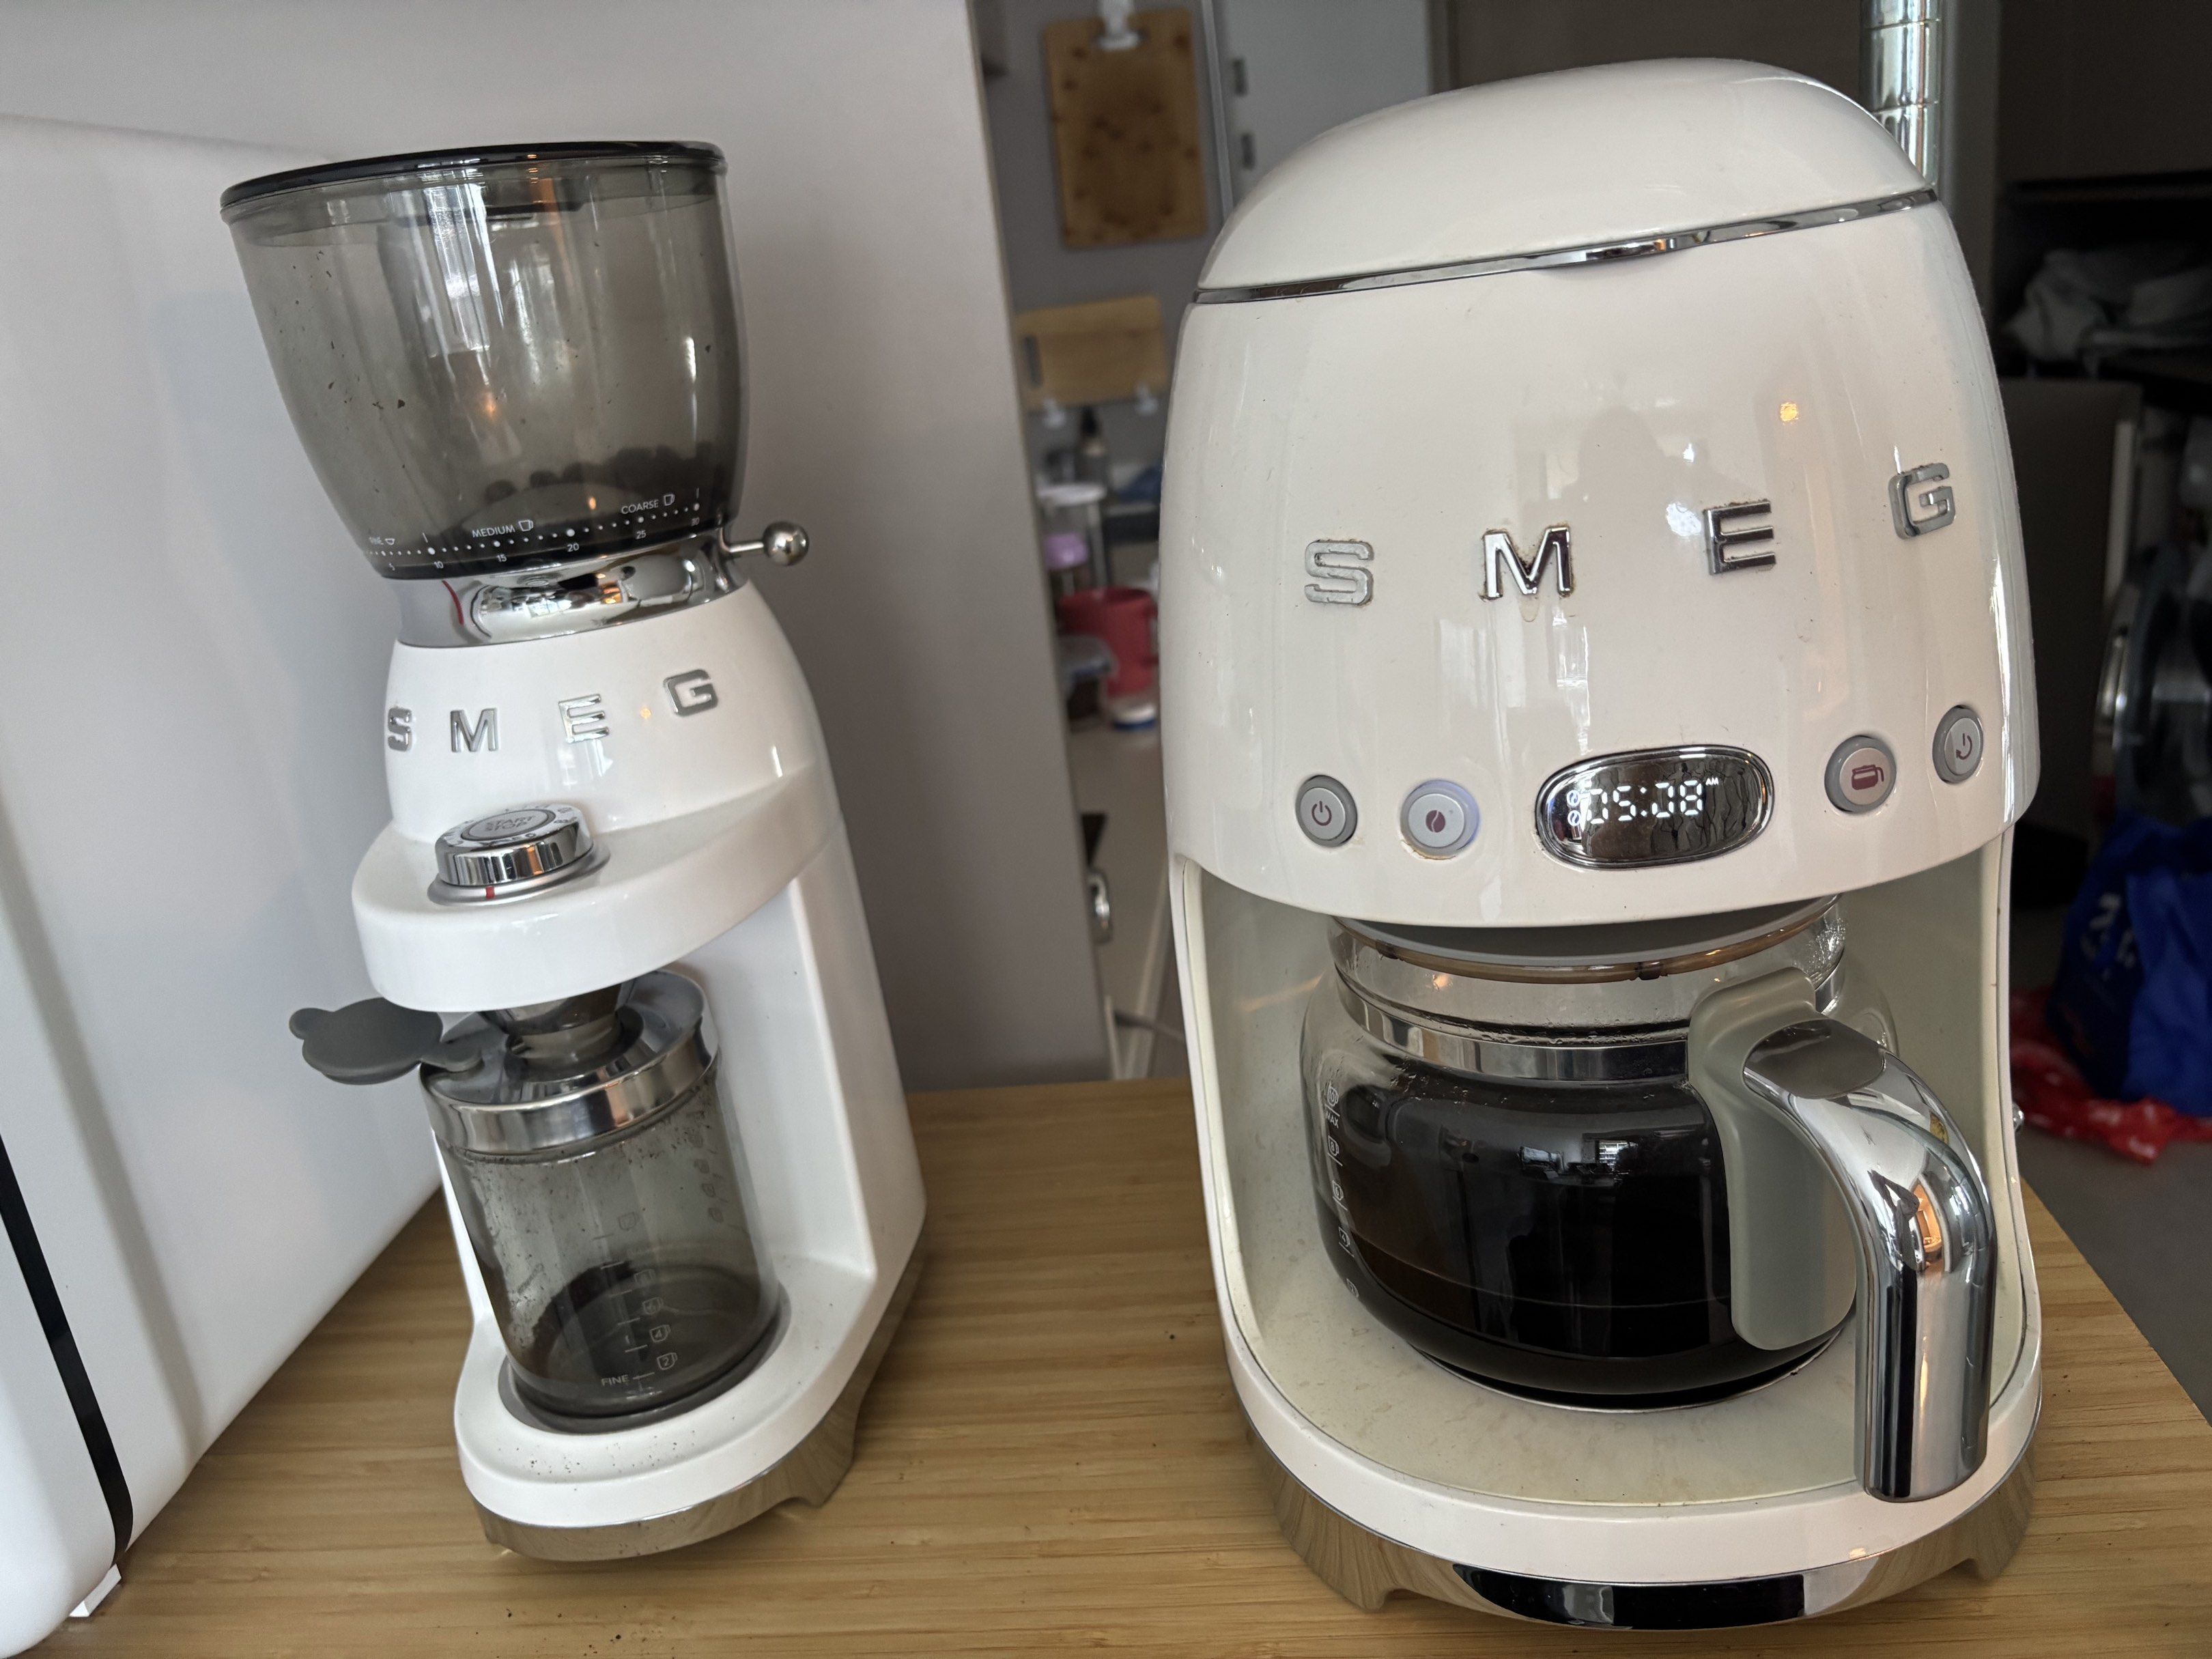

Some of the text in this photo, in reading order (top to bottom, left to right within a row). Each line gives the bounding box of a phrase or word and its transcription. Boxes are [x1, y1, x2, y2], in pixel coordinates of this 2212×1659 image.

[621, 499, 659, 514] COARSE
[472, 525, 515, 538] MEDIUM
[1305, 462, 1957, 607] SMEG
[434, 561, 444, 569] 10
[497, 554, 507, 563] 15
[567, 542, 580, 552] 20
[635, 530, 647, 539] 25
[691, 517, 700, 526] 30
[387, 668, 719, 753] SMEG
[1705, 777, 1719, 786] AM
[1326, 1111, 1339, 1129] MAX
[655, 1329, 662, 1338] 4
[663, 1357, 669, 1366] 2
[601, 1374, 629, 1387] FINE
